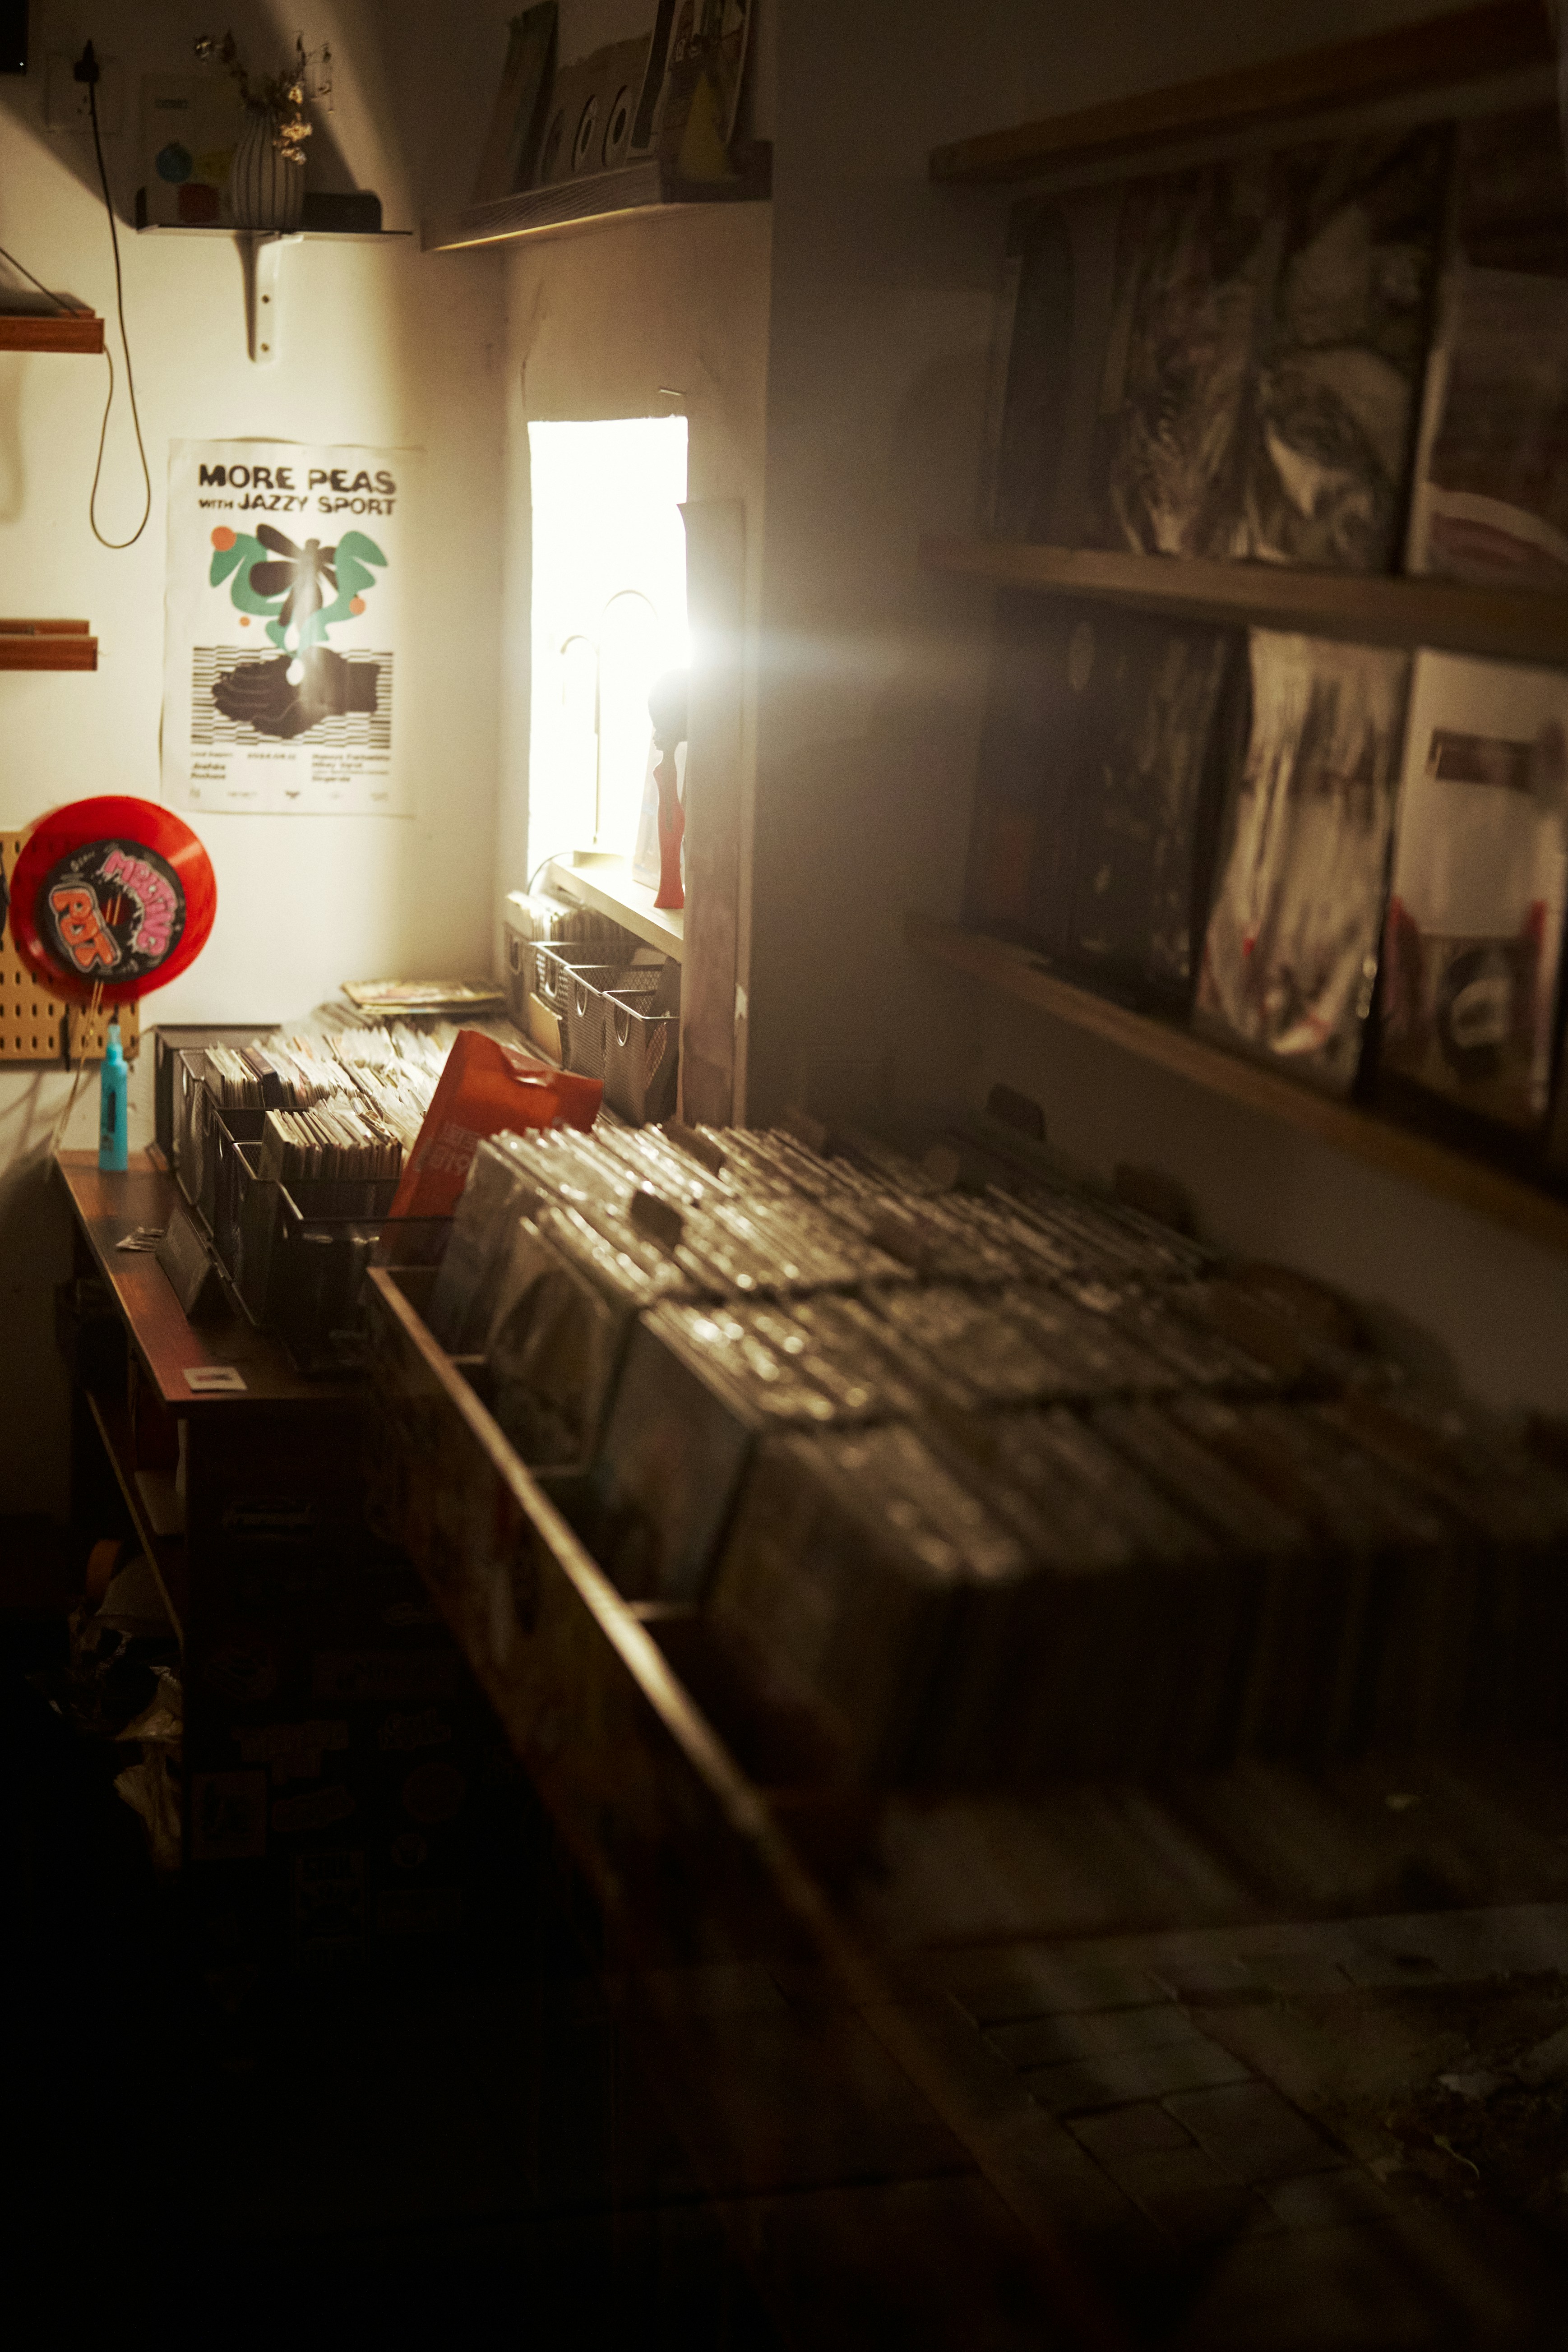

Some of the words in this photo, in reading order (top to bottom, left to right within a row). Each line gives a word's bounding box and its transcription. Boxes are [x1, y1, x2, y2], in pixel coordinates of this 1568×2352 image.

[199, 464, 295, 490] MORE
[309, 469, 396, 494] PEAS
[199, 499, 233, 509] WITH
[238, 493, 308, 512] JAZZY
[318, 496, 396, 515] SPORT
[52, 889, 113, 966] POT
